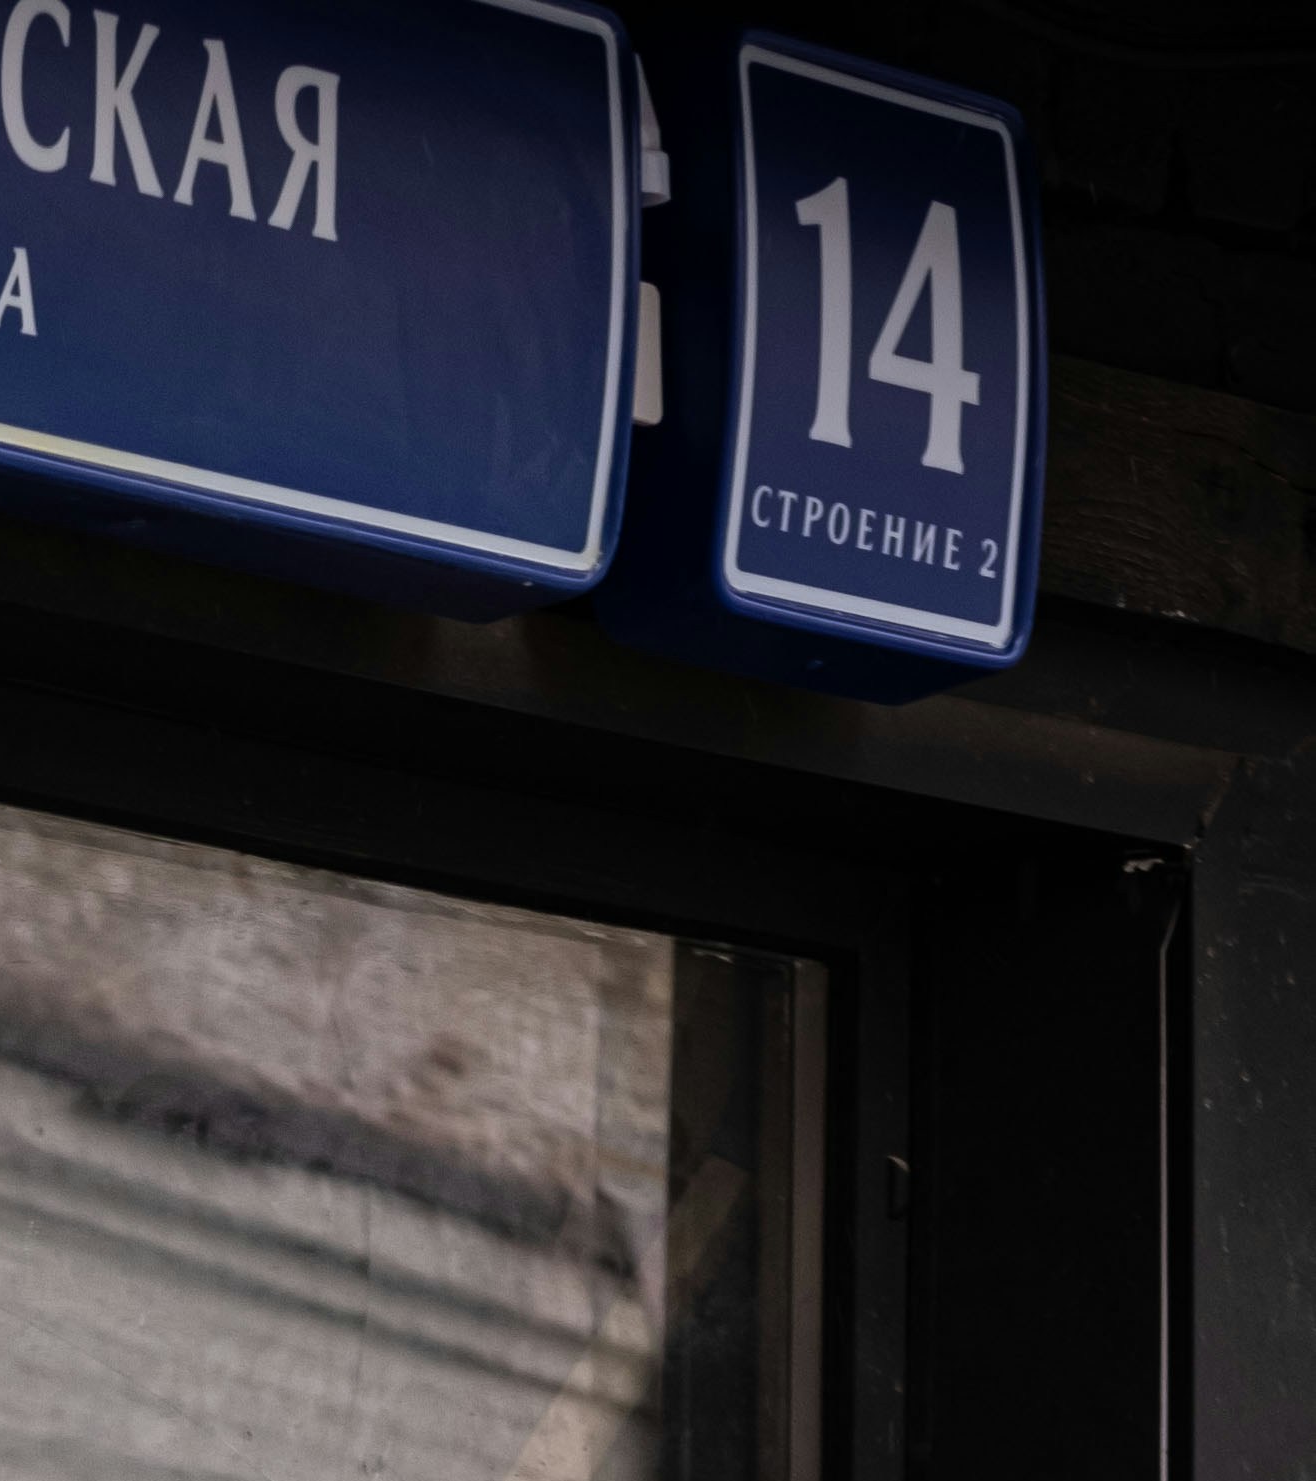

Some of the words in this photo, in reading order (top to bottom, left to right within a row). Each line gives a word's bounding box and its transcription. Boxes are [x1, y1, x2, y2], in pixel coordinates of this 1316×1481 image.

[796, 177, 980, 475] 14
[751, 485, 964, 571] СТРОЕНИЕ
[980, 538, 999, 579] 2
